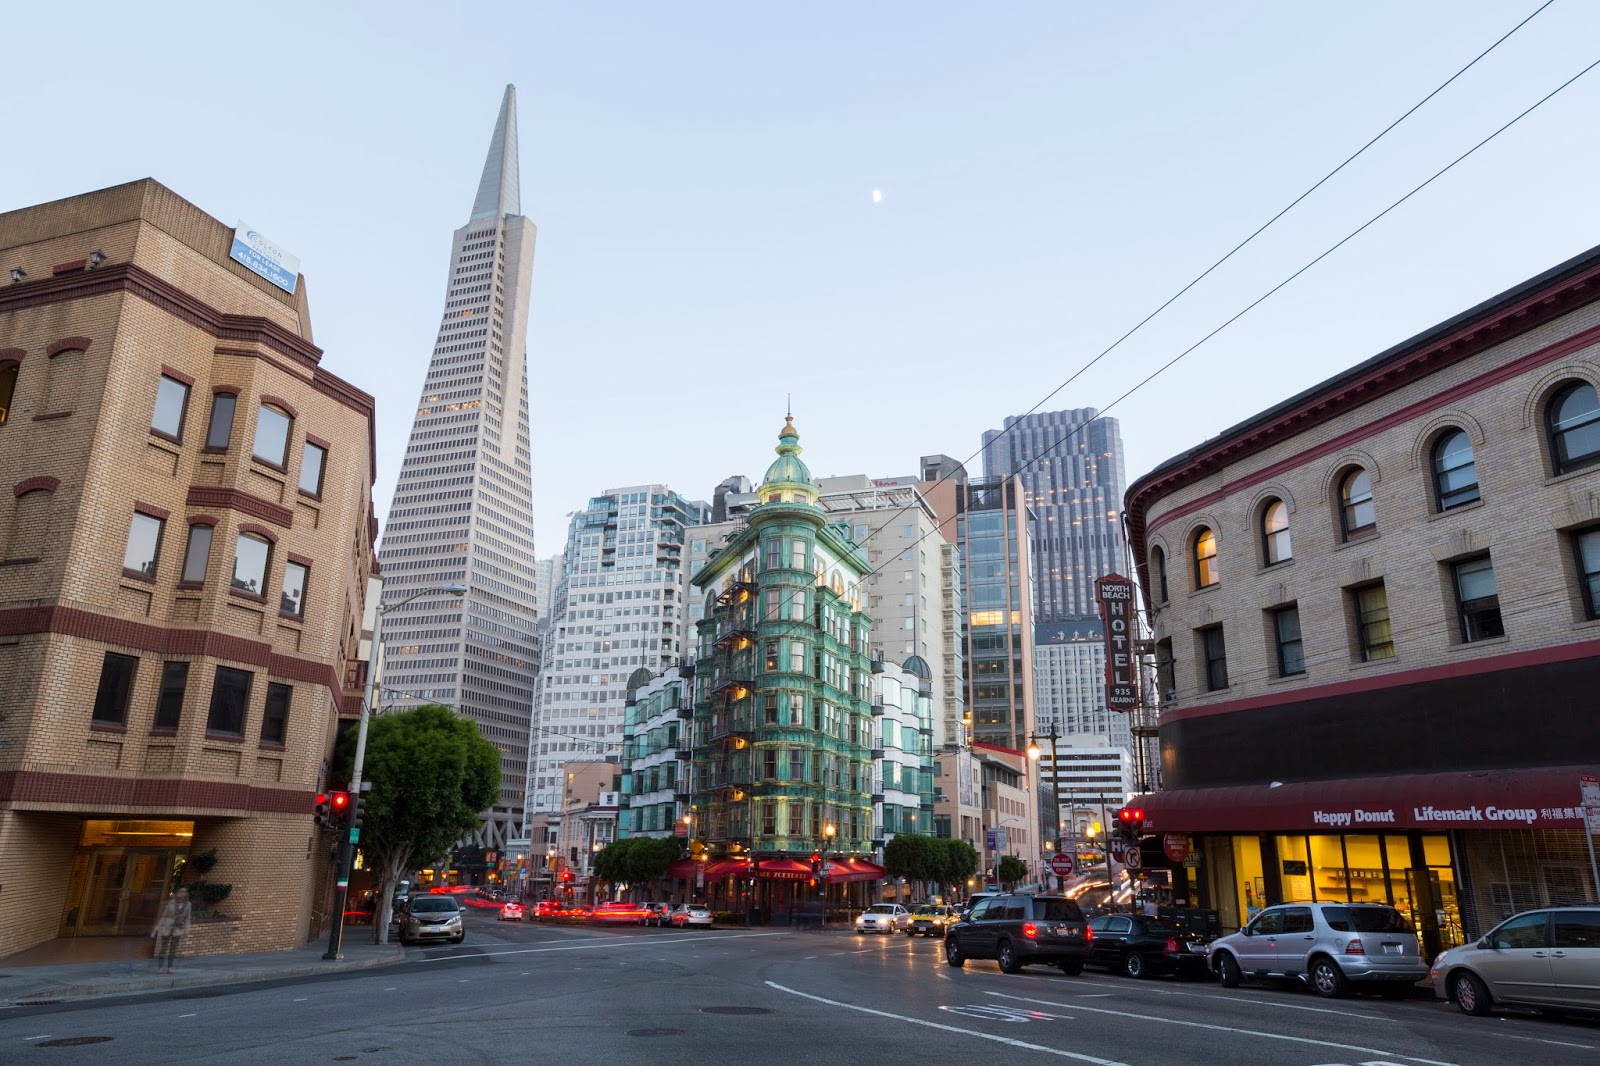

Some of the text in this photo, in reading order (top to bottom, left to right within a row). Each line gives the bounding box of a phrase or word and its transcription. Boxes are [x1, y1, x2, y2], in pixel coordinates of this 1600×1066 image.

[253, 236, 282, 258] COLTON
[237, 252, 289, 286] 415.834.1600
[248, 249, 281, 273] FOR LEASE
[1102, 584, 1130, 593] NORTH
[1102, 591, 1130, 599] BEACH
[1111, 602, 1130, 685] HOTEL
[1313, 809, 1395, 826] Happy Donut
[1413, 805, 1538, 824] Lifemark Group
